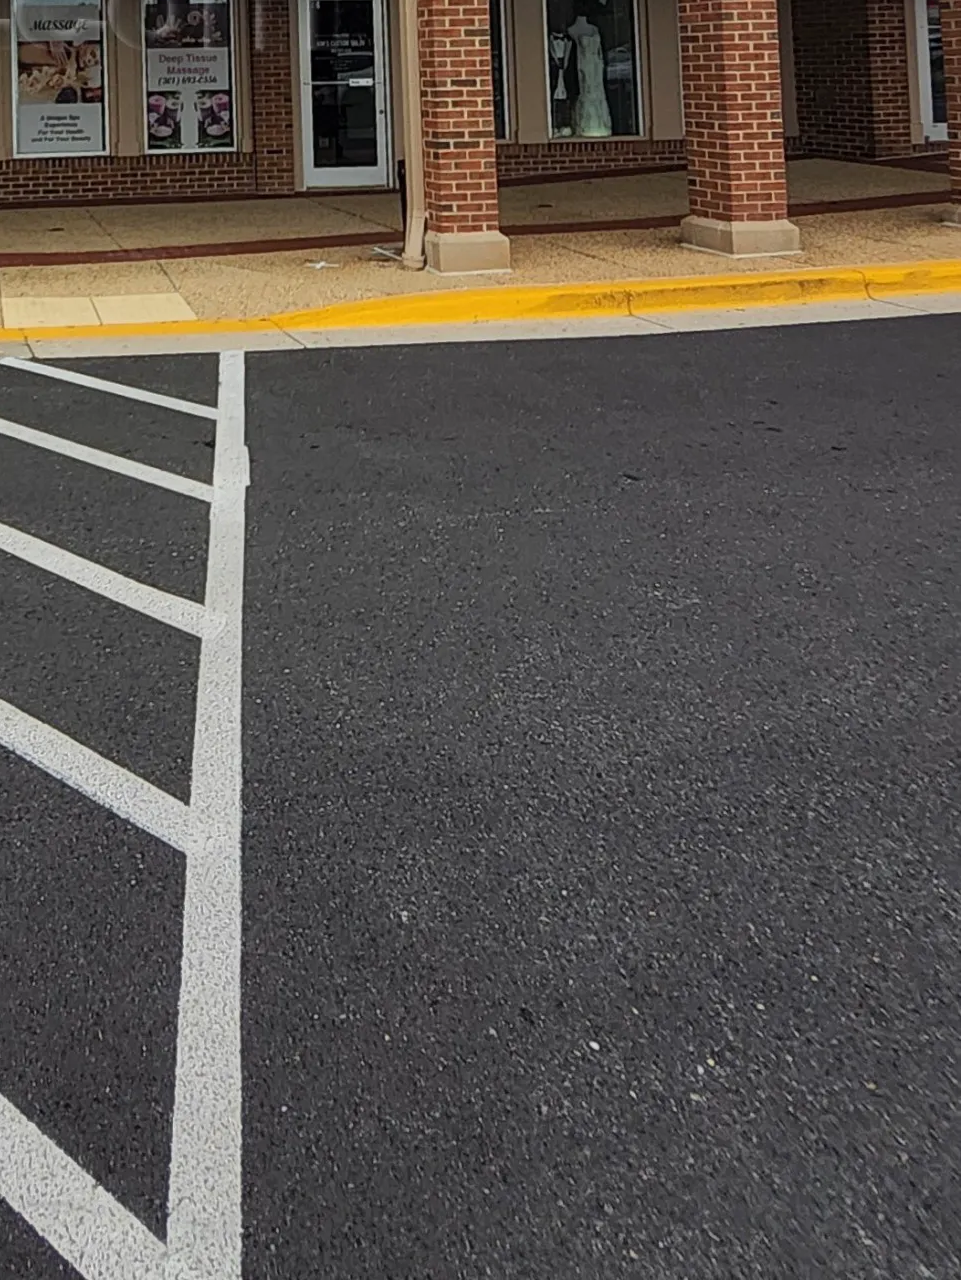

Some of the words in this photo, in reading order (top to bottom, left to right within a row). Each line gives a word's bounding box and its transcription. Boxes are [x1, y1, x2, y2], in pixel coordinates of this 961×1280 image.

[158, 54, 184, 64] Deep
[186, 53, 218, 63] Tissue
[166, 66, 209, 76] Massage
